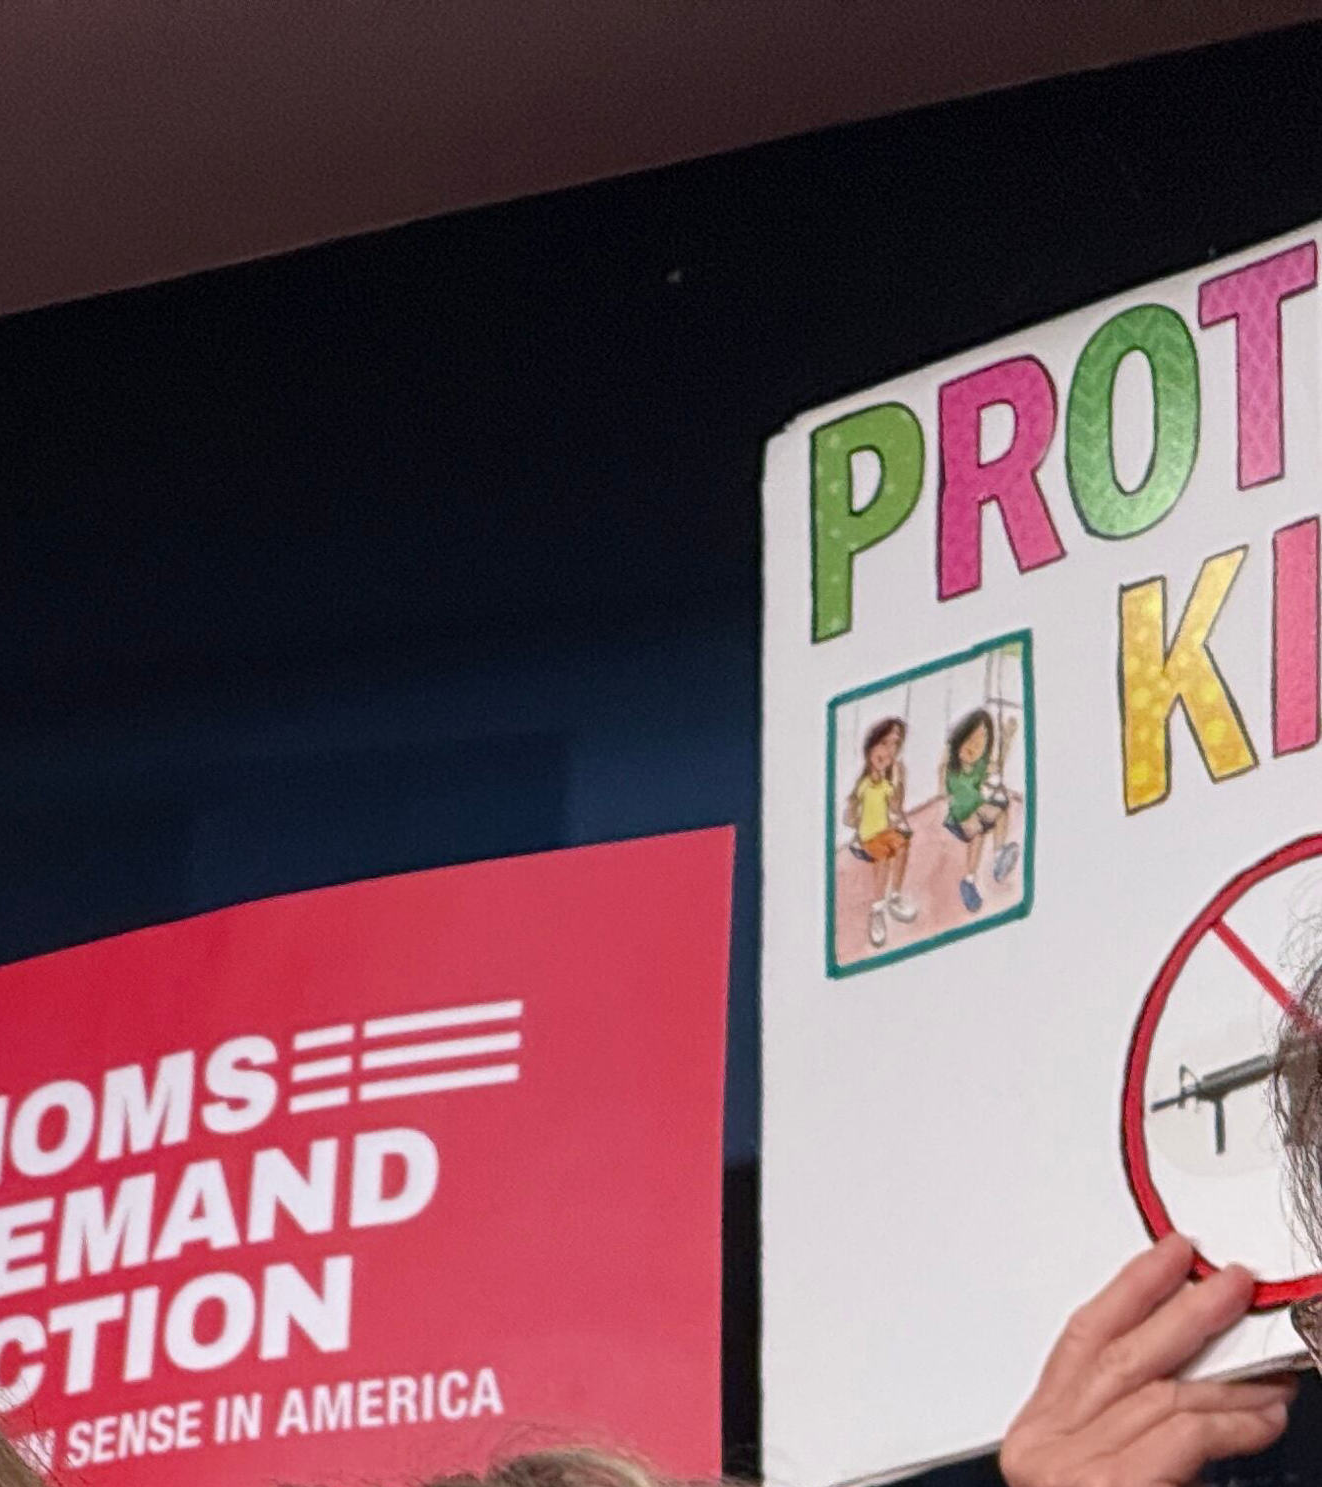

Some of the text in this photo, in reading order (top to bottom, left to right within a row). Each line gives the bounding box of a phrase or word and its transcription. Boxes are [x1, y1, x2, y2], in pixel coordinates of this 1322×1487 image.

[810, 239, 1318, 644] PROT
[1119, 515, 1321, 816] KI
[65, 1401, 203, 1469] SENSE
[215, 1391, 261, 1445] IN
[276, 1366, 504, 1437] AMERICA
